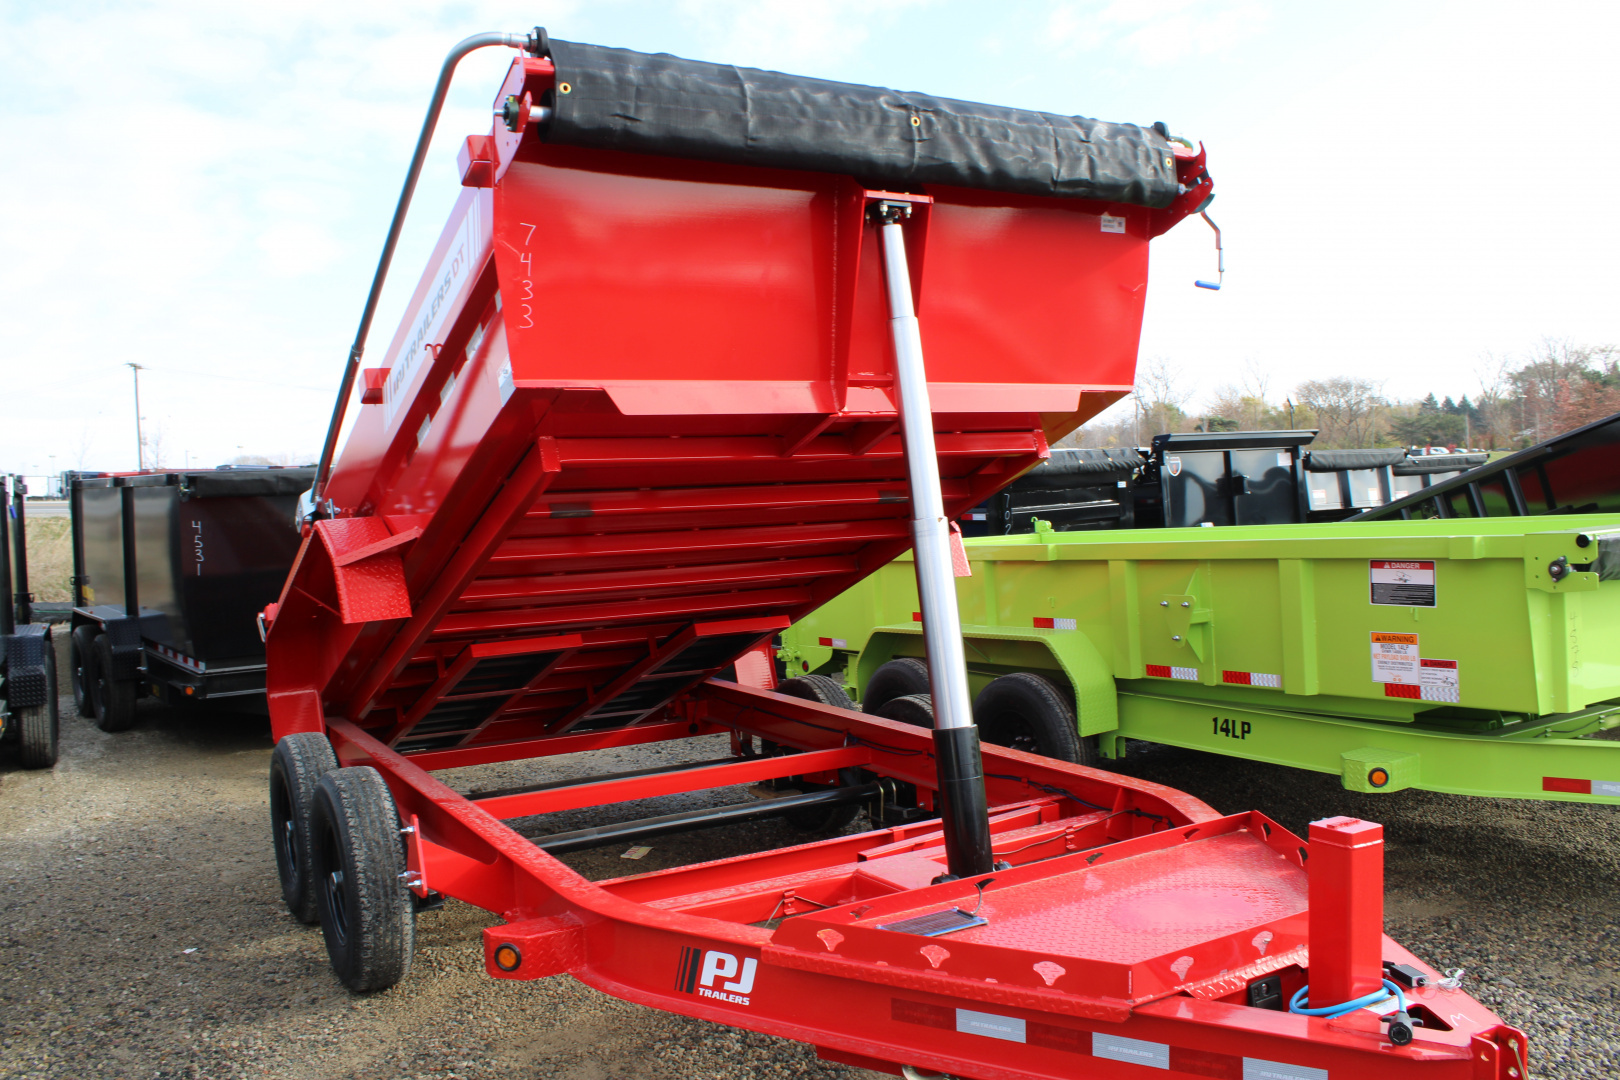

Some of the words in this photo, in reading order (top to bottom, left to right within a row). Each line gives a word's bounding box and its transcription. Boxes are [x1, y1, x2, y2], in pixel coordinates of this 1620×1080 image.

[520, 222, 536, 329] 7433
[404, 269, 452, 372] TRAILERS
[452, 242, 465, 279] DT
[191, 520, 205, 577] 4531
[1381, 635, 1414, 643] WARNING
[1212, 716, 1252, 740] 14LP
[700, 950, 757, 994] PJ
[698, 987, 750, 1006] TRAILERS
[1118, 1047, 1154, 1058] TRAILERS
